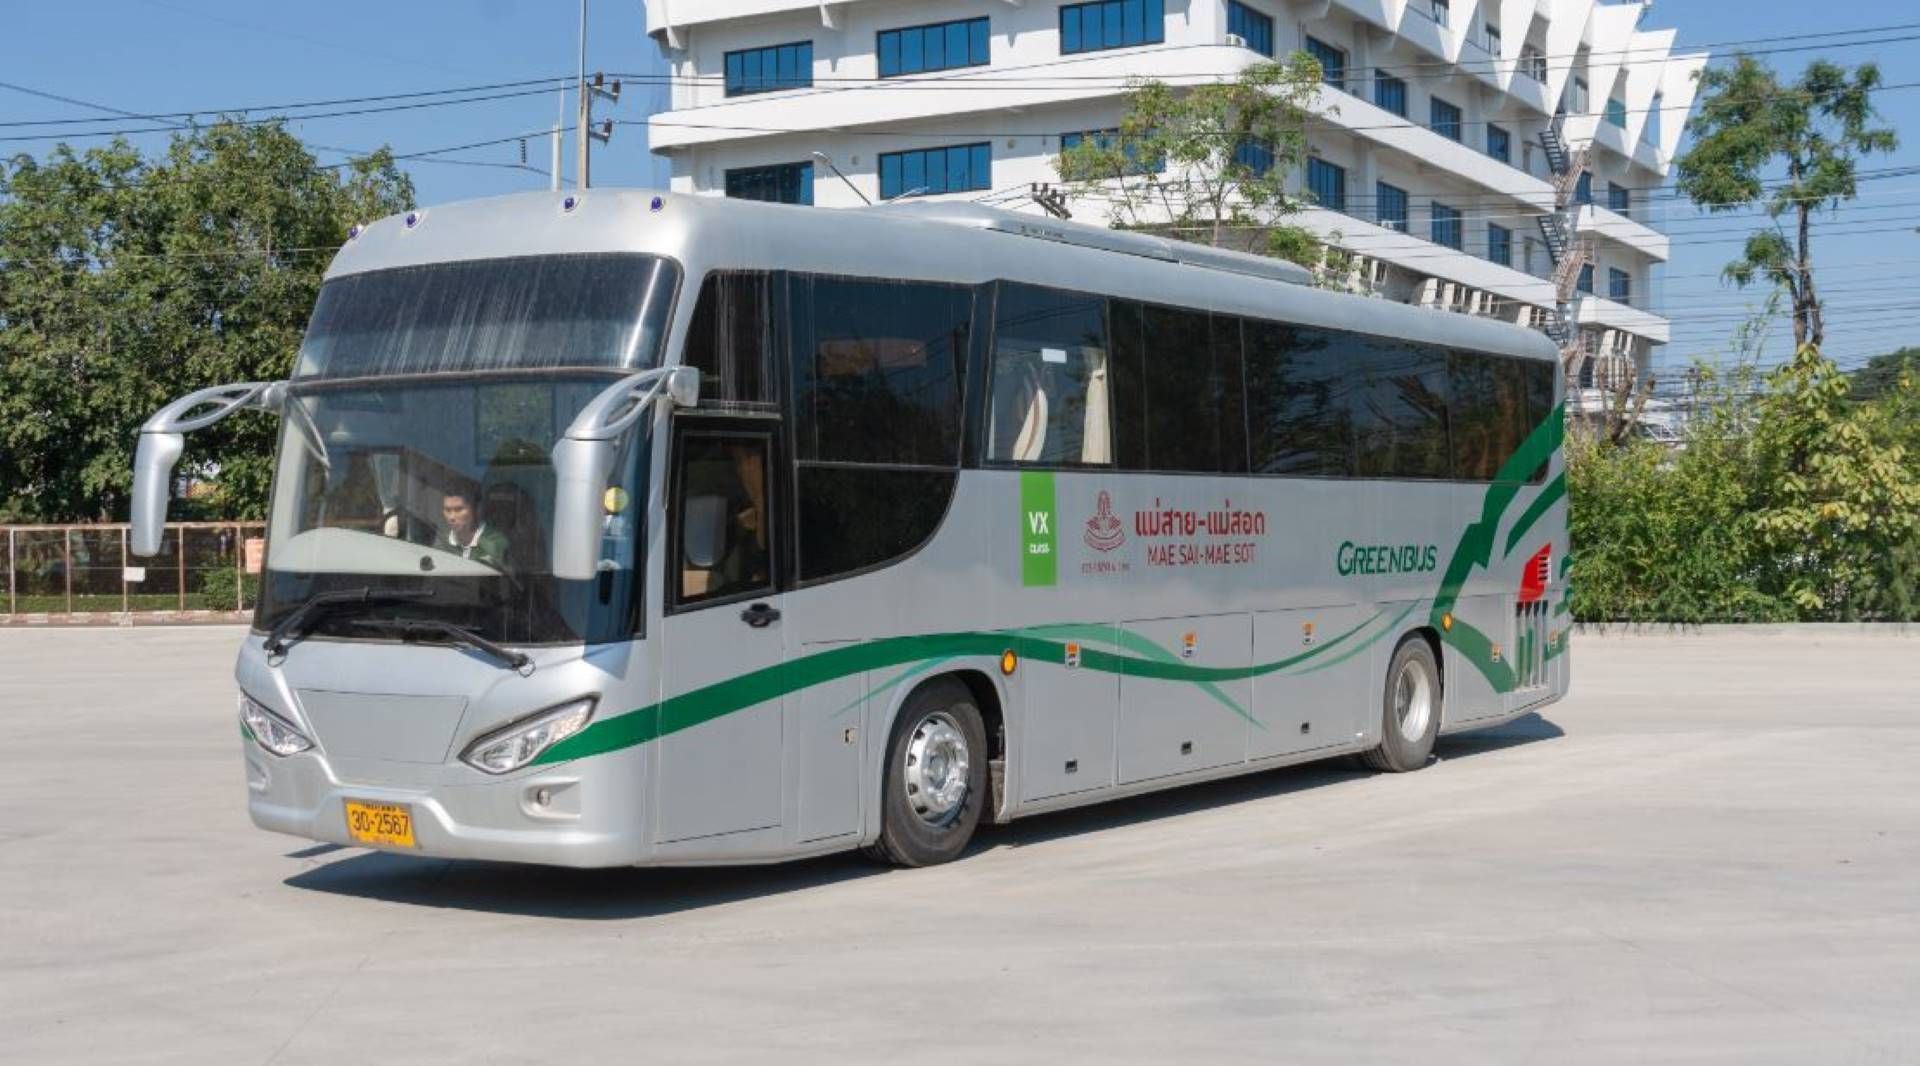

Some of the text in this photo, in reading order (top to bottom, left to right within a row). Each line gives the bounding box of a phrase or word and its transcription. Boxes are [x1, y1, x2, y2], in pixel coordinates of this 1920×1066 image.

[1029, 511, 1049, 534] VX
[1147, 543, 1177, 566] MAE
[1234, 543, 1256, 564] SOT
